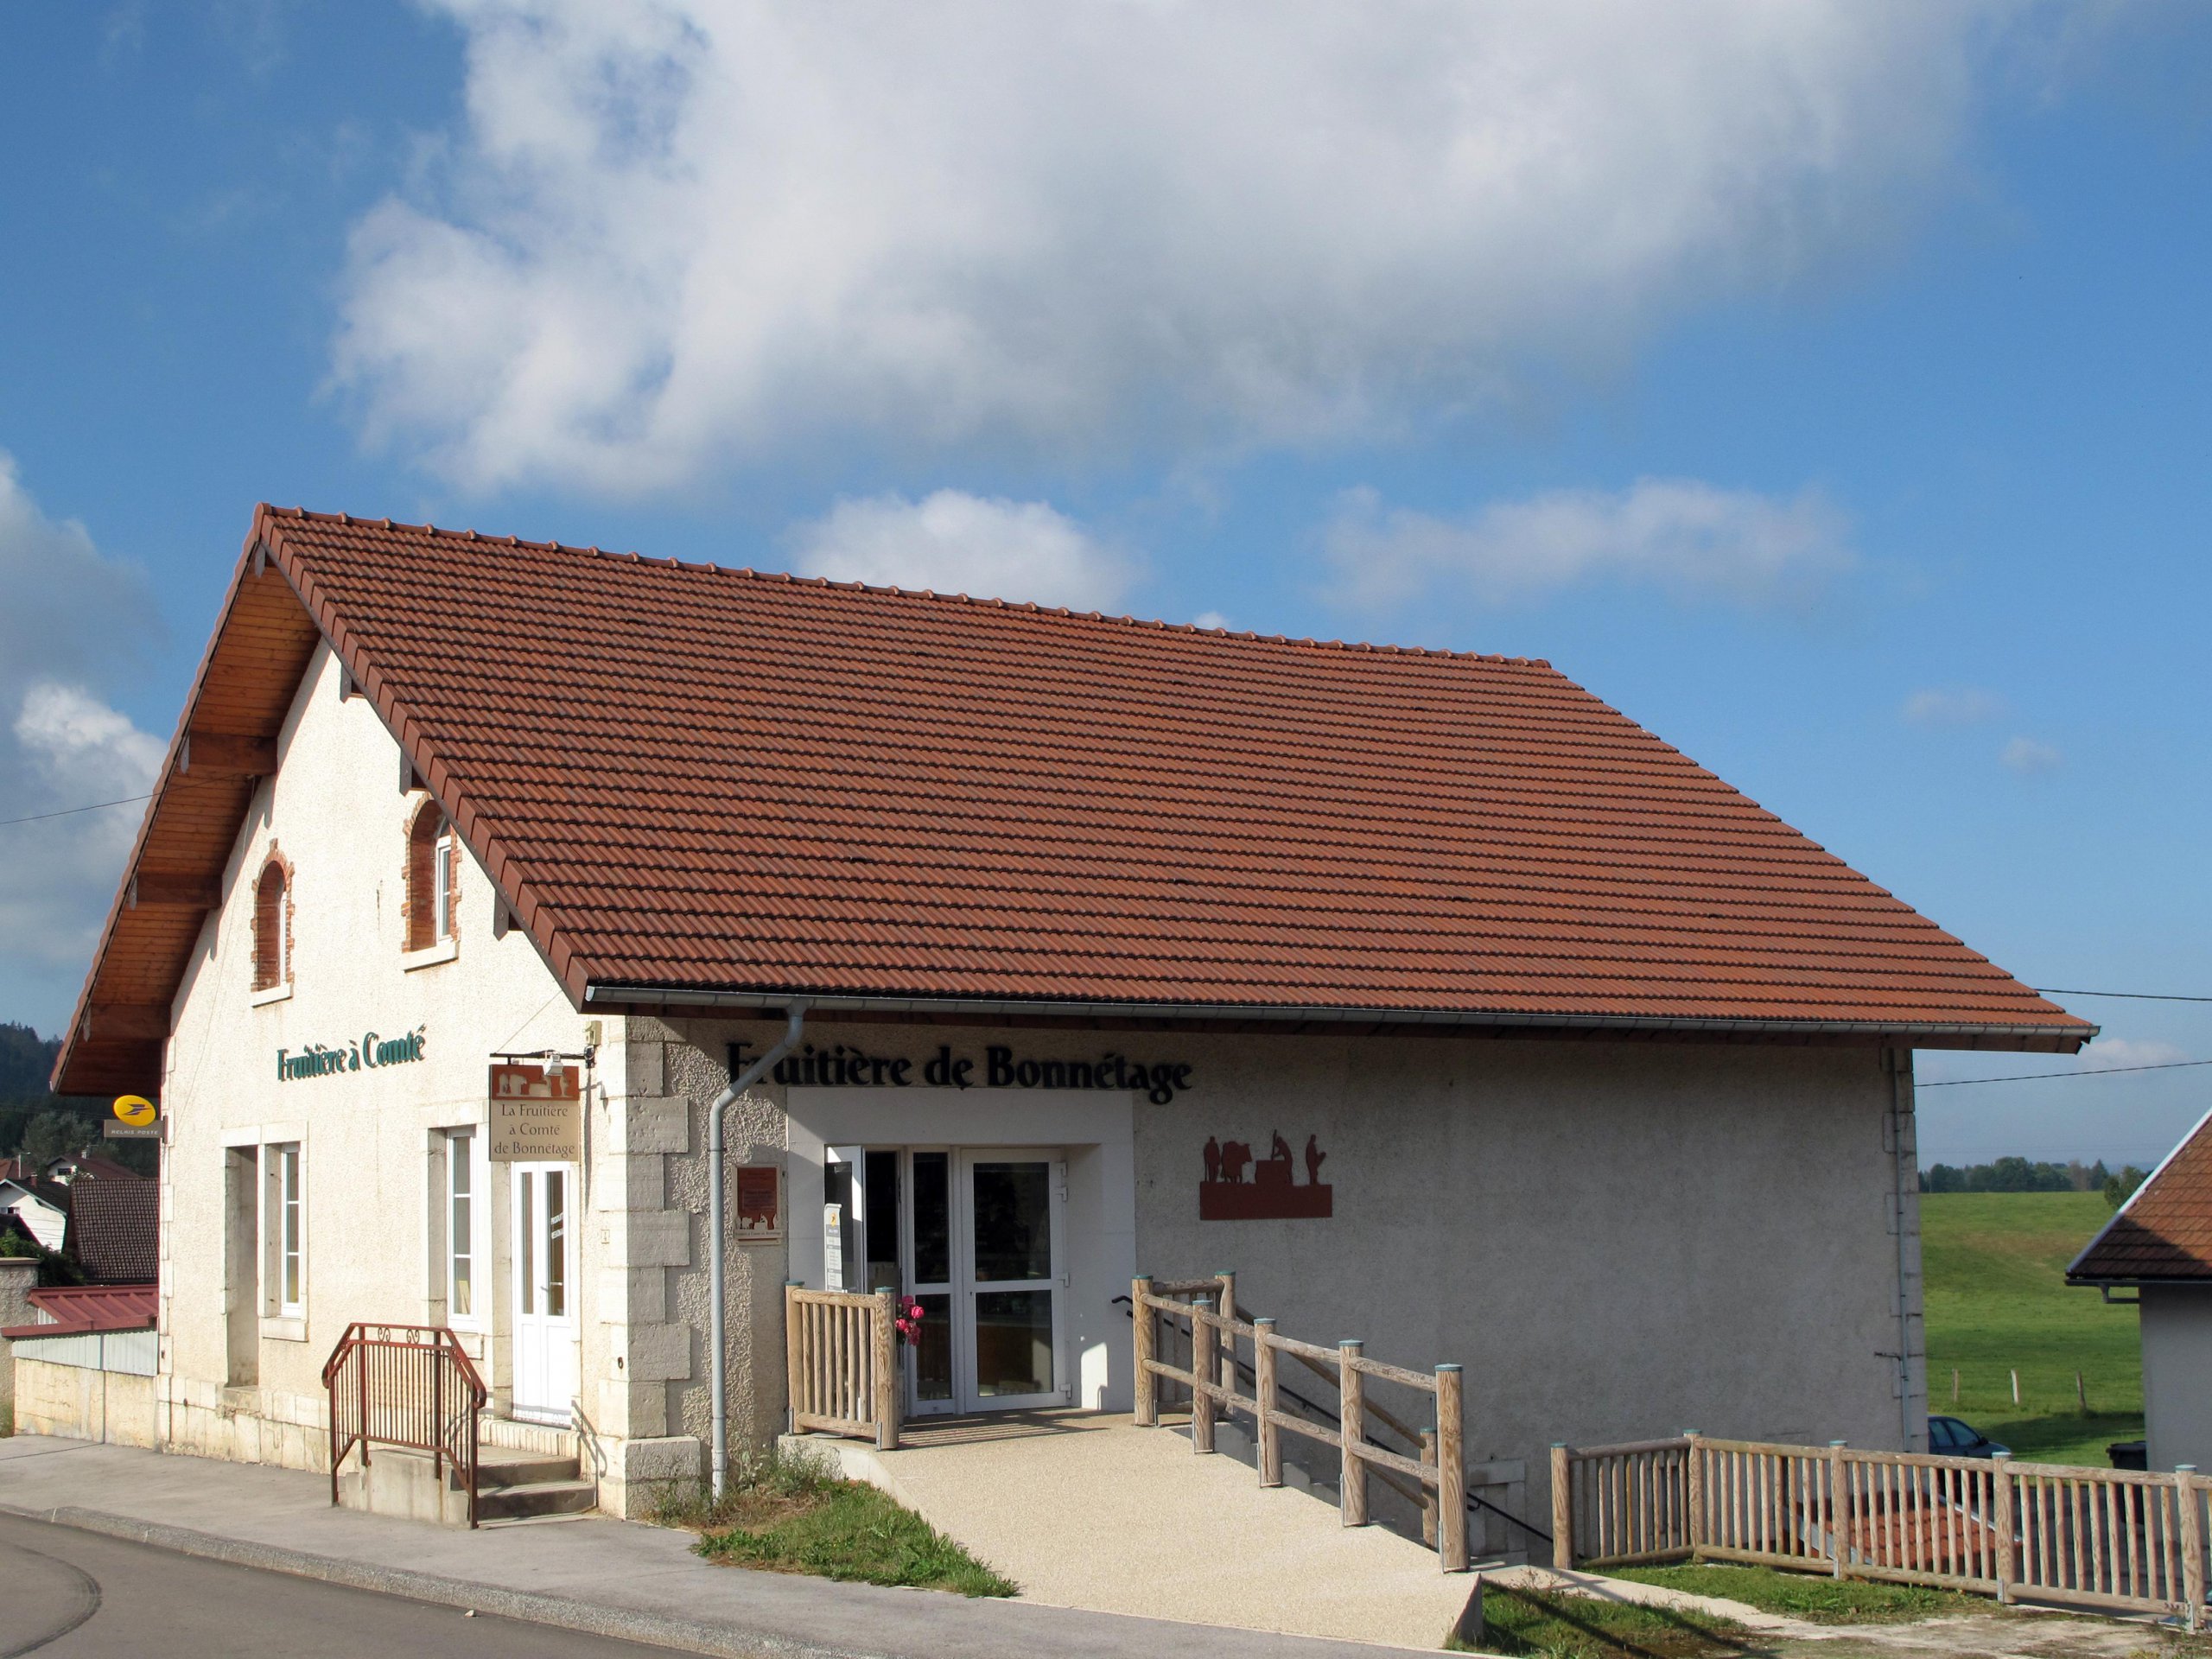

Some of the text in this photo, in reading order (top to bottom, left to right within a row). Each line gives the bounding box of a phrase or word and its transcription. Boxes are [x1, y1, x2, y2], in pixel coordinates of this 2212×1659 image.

[277, 1023, 426, 1082] Fruitière à Comté
[924, 1045, 974, 1087] de
[986, 1046, 1193, 1105] Bonnétage
[502, 1103, 569, 1117] La Fruitière
[509, 1122, 561, 1135] à Comté
[494, 1141, 575, 1159] de Bonnétage
